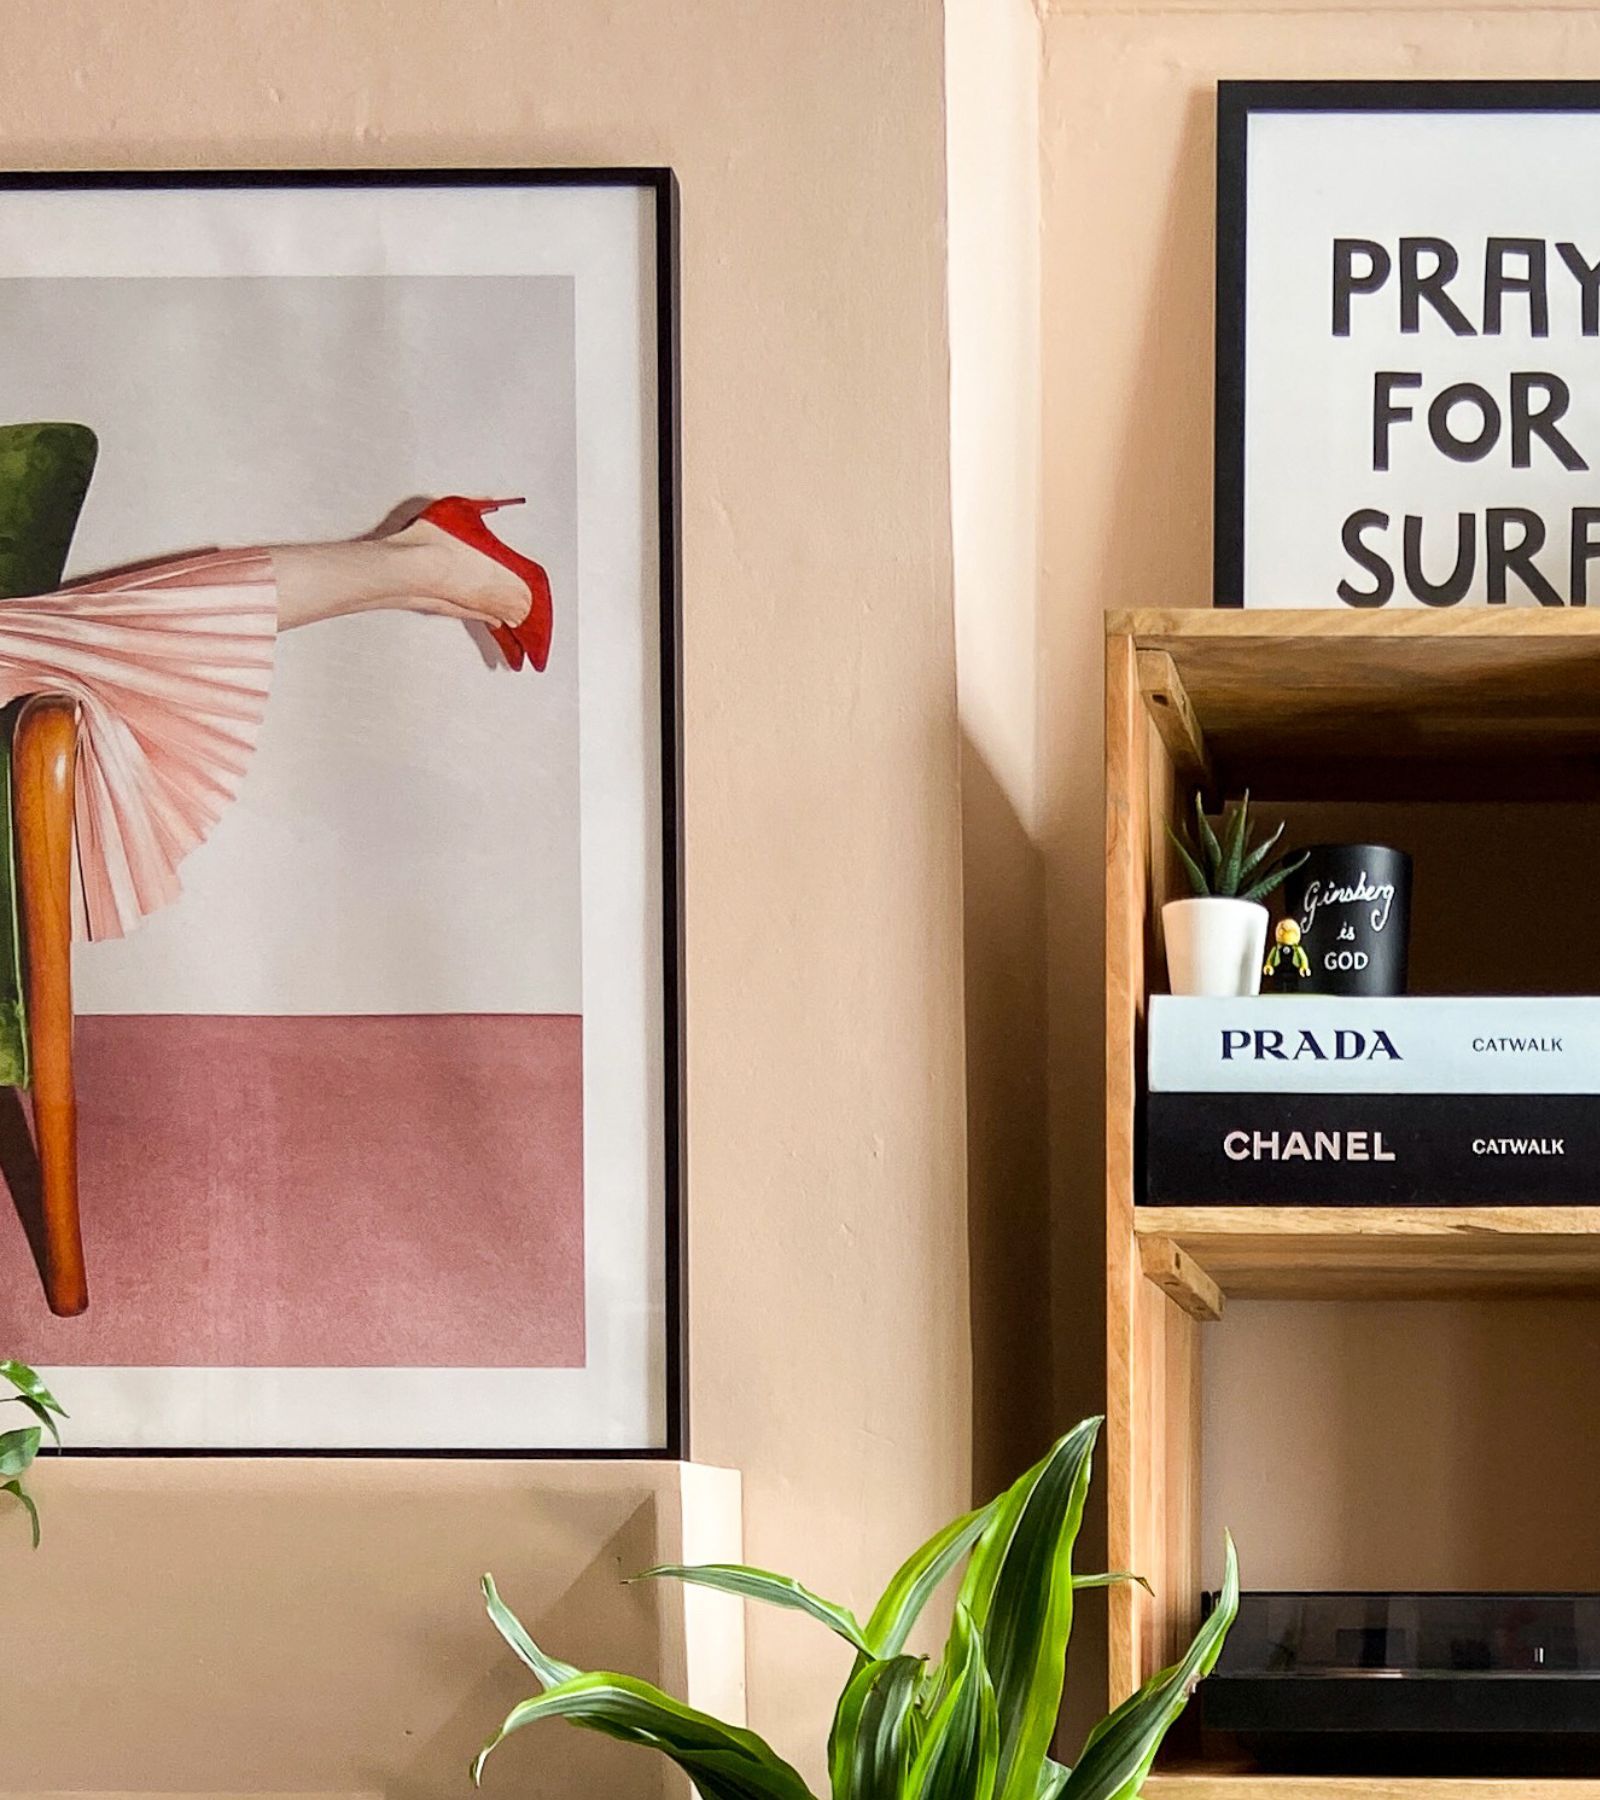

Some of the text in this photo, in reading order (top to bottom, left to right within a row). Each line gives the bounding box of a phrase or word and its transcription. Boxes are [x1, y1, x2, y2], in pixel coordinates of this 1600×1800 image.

[1373, 371, 1590, 472] FOR
[1300, 871, 1395, 932] Ginsberg
[1336, 922, 1356, 941] is
[1324, 951, 1369, 970] GOD
[1221, 1029, 1563, 1061] PRADA CATWALK
[1223, 1131, 1565, 1162] CHANEL CATWALK
